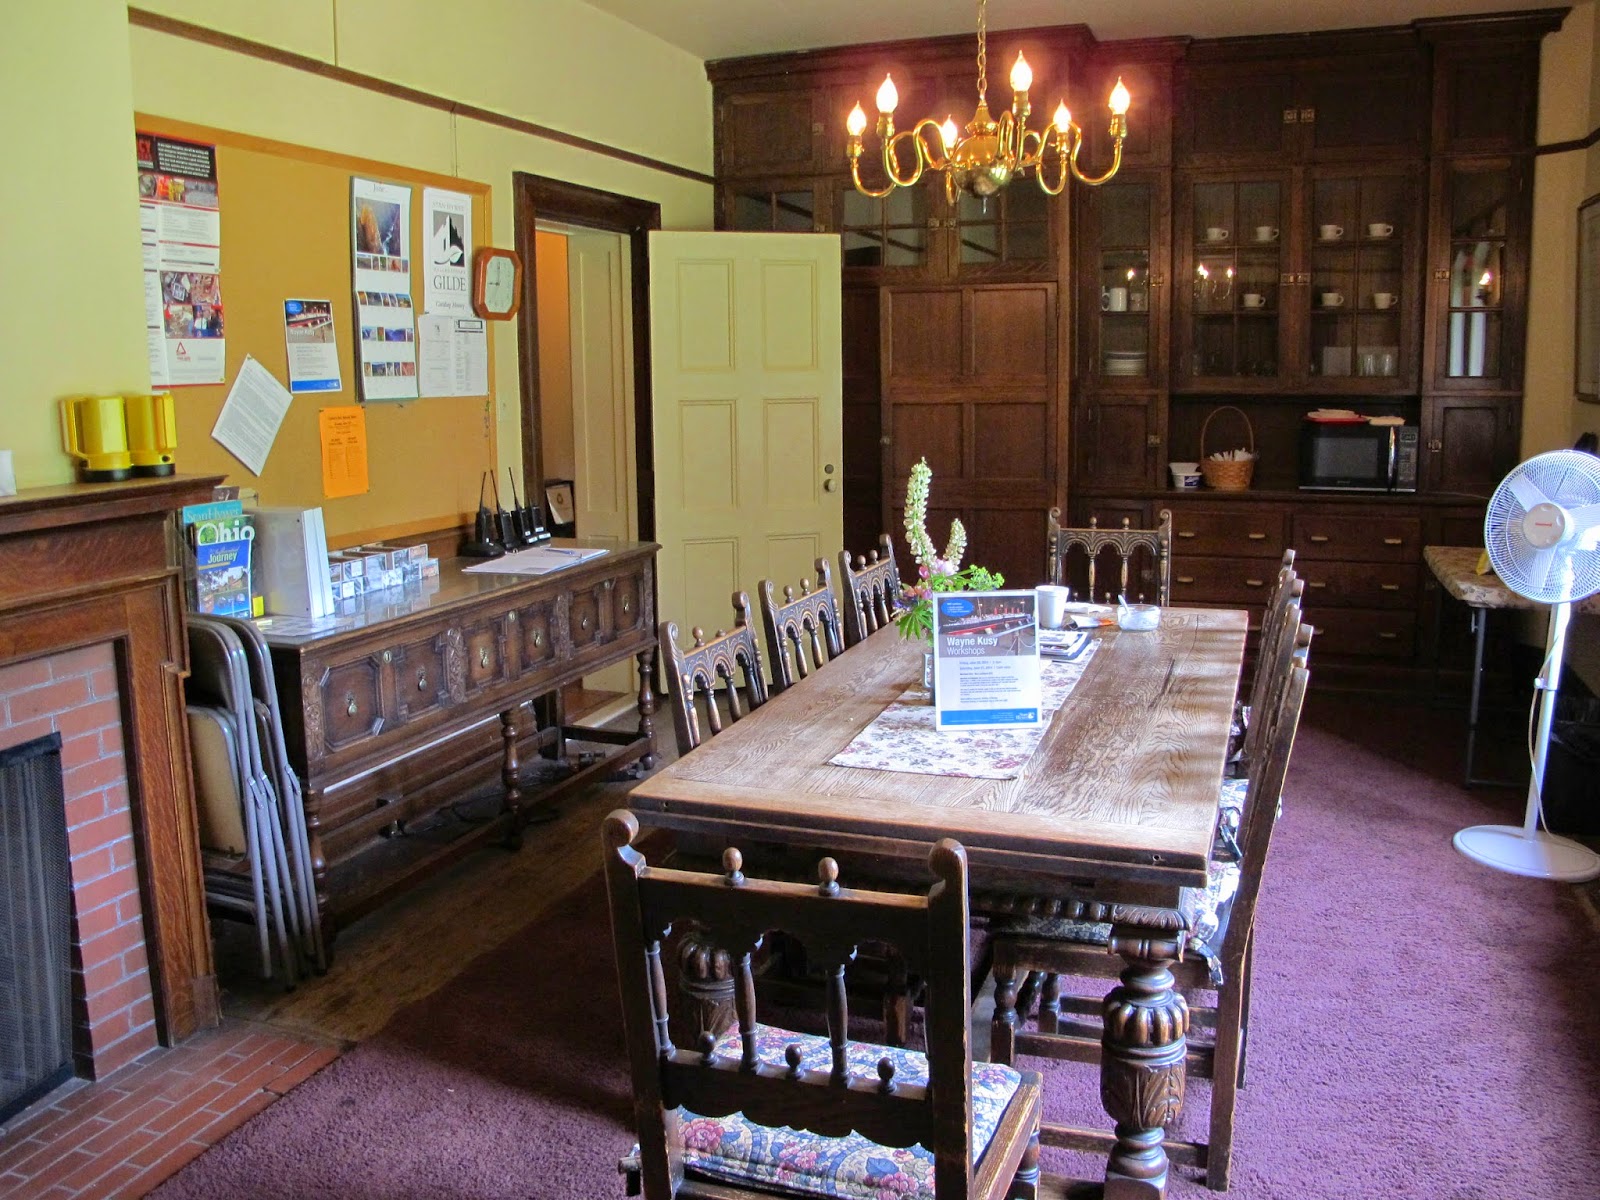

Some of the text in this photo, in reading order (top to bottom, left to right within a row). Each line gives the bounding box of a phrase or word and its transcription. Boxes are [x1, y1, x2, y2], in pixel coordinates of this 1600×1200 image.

[433, 274, 467, 291] GILDE
[198, 520, 255, 545] Ohio
[208, 551, 238, 564] Journey
[947, 636, 998, 648] Wayne Kusy
[947, 647, 985, 656] Workshops
